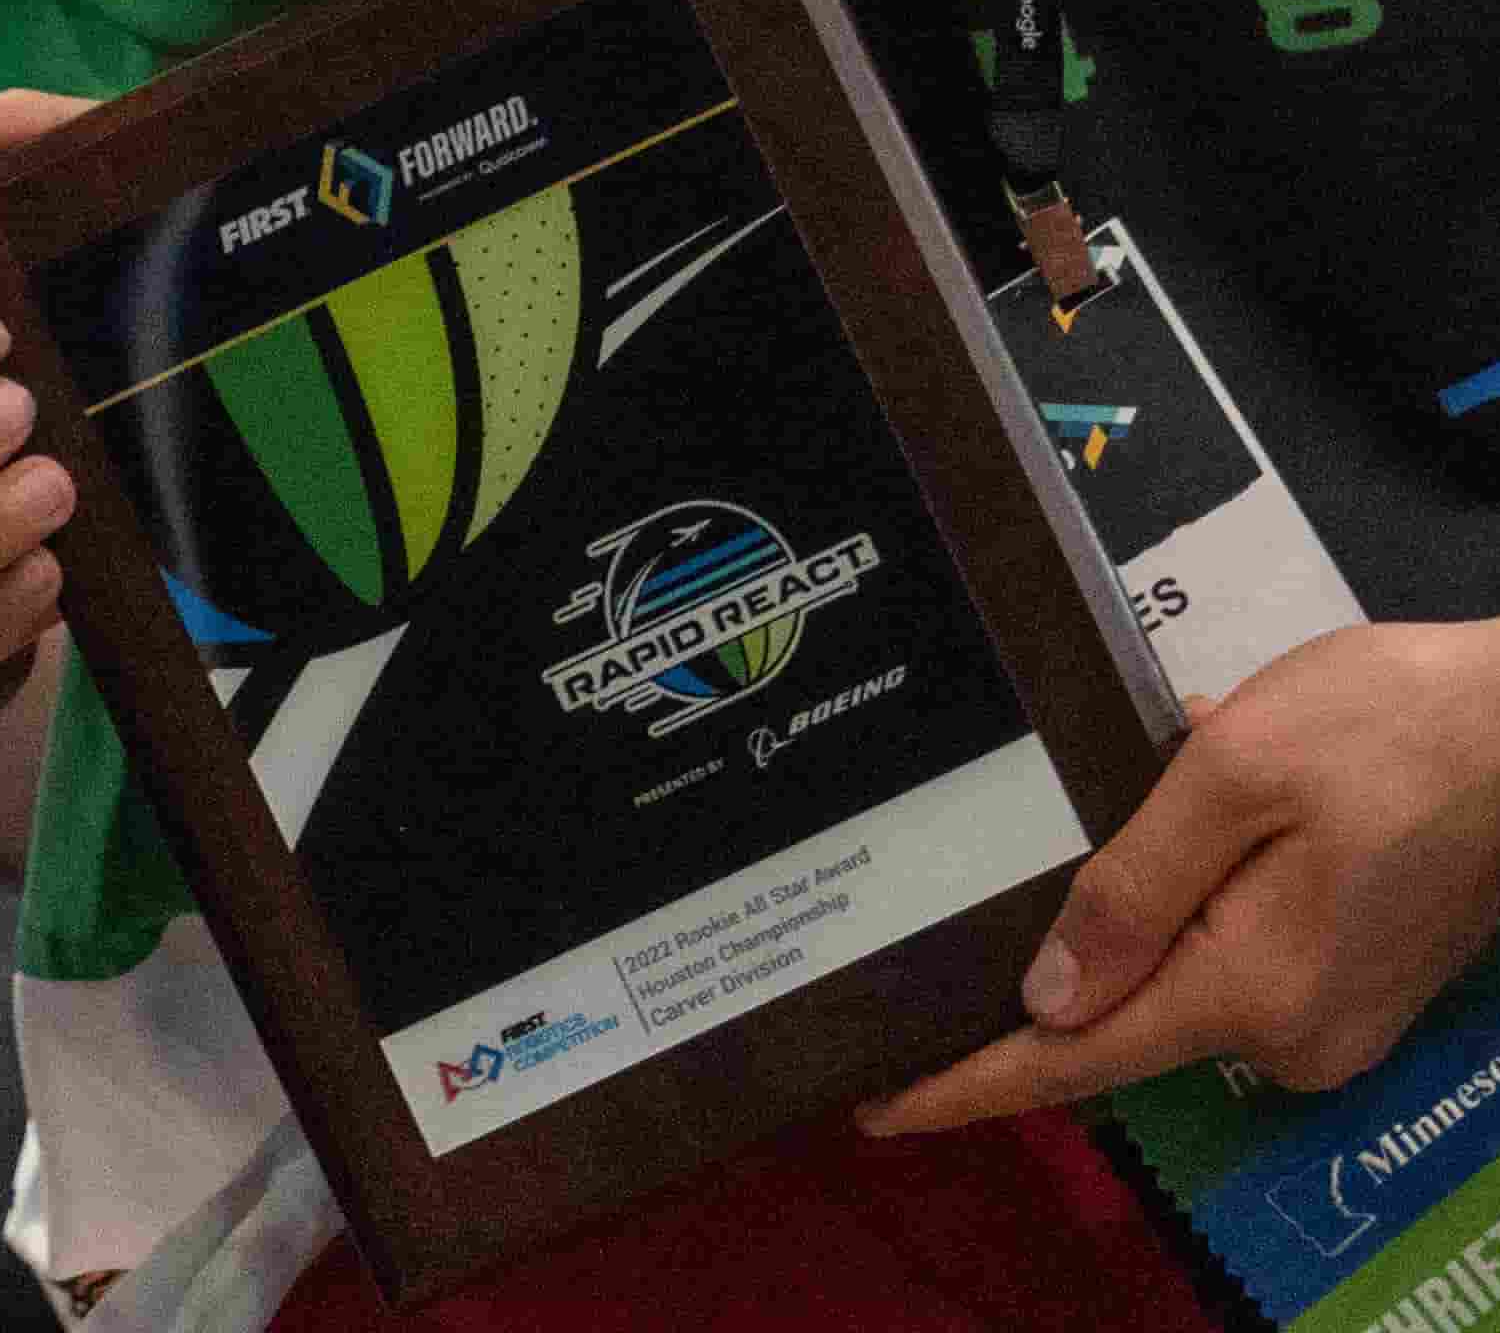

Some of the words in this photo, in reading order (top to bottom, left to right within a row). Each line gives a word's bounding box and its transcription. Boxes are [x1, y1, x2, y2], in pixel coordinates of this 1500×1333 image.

[219, 186, 311, 254] FIRST
[562, 619, 705, 705] RAPID
[712, 540, 875, 632] REACT
[705, 756, 725, 776] BY
[788, 665, 908, 736] BOEING
[623, 940, 673, 975] 2022
[675, 910, 742, 950] Rookie
[743, 896, 769, 920] All
[769, 876, 809, 906] Star
[814, 844, 872, 886] Award
[636, 955, 717, 1000] Houston
[718, 892, 850, 962] Championship
[500, 1011, 545, 1045] FIRST
[650, 986, 717, 1028] Carver
[720, 946, 805, 995] Division
